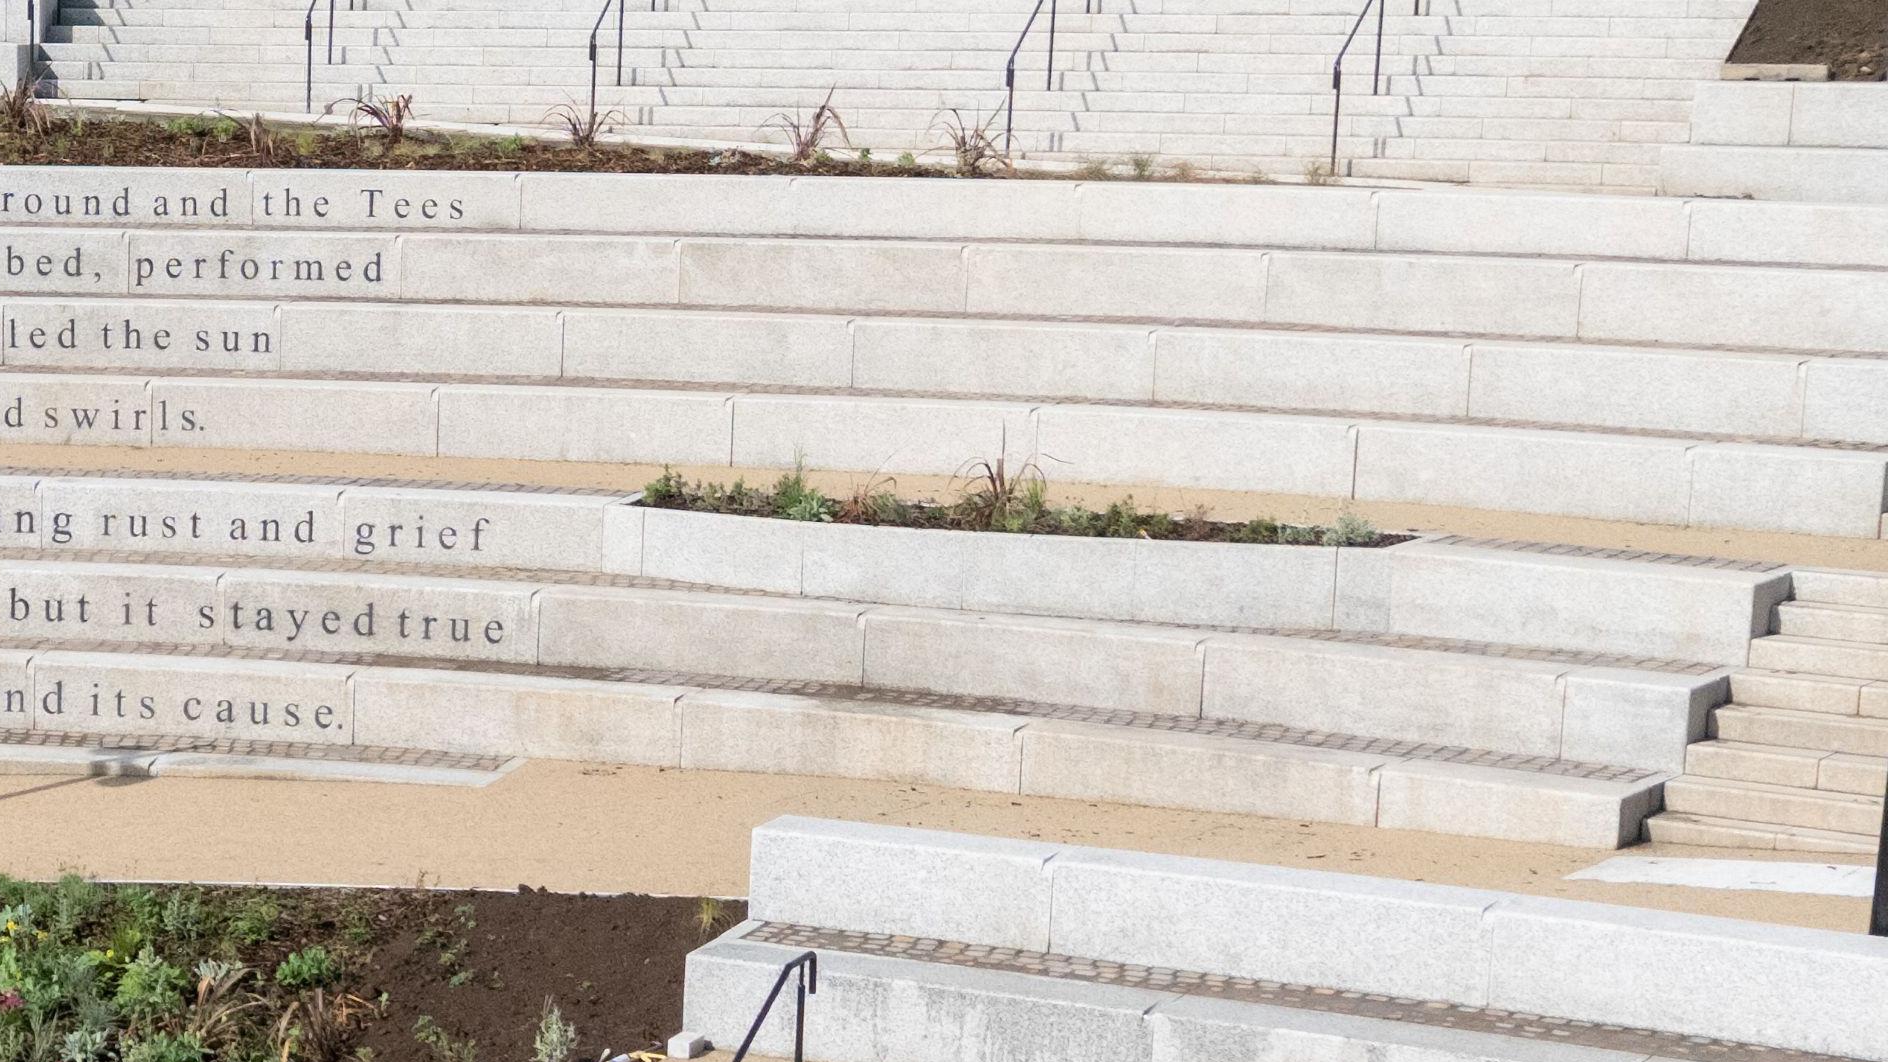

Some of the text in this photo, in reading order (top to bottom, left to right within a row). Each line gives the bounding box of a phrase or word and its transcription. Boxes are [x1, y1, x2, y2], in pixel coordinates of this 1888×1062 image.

[1, 187, 130, 217] round
[154, 188, 228, 217] and
[264, 188, 329, 217] the
[361, 190, 463, 219] Tees
[7, 246, 100, 283] bed,
[134, 250, 384, 287] performed
[101, 319, 170, 350] the
[196, 331, 271, 353] sun
[44, 400, 206, 433] swirls.
[102, 512, 201, 538] rust
[230, 511, 314, 543] and
[354, 515, 489, 555] grief
[9, 588, 89, 623] but
[123, 592, 158, 626] it
[198, 602, 375, 641] stayed
[398, 609, 503, 644] true
[91, 683, 155, 719] its
[183, 698, 342, 729] cause.
